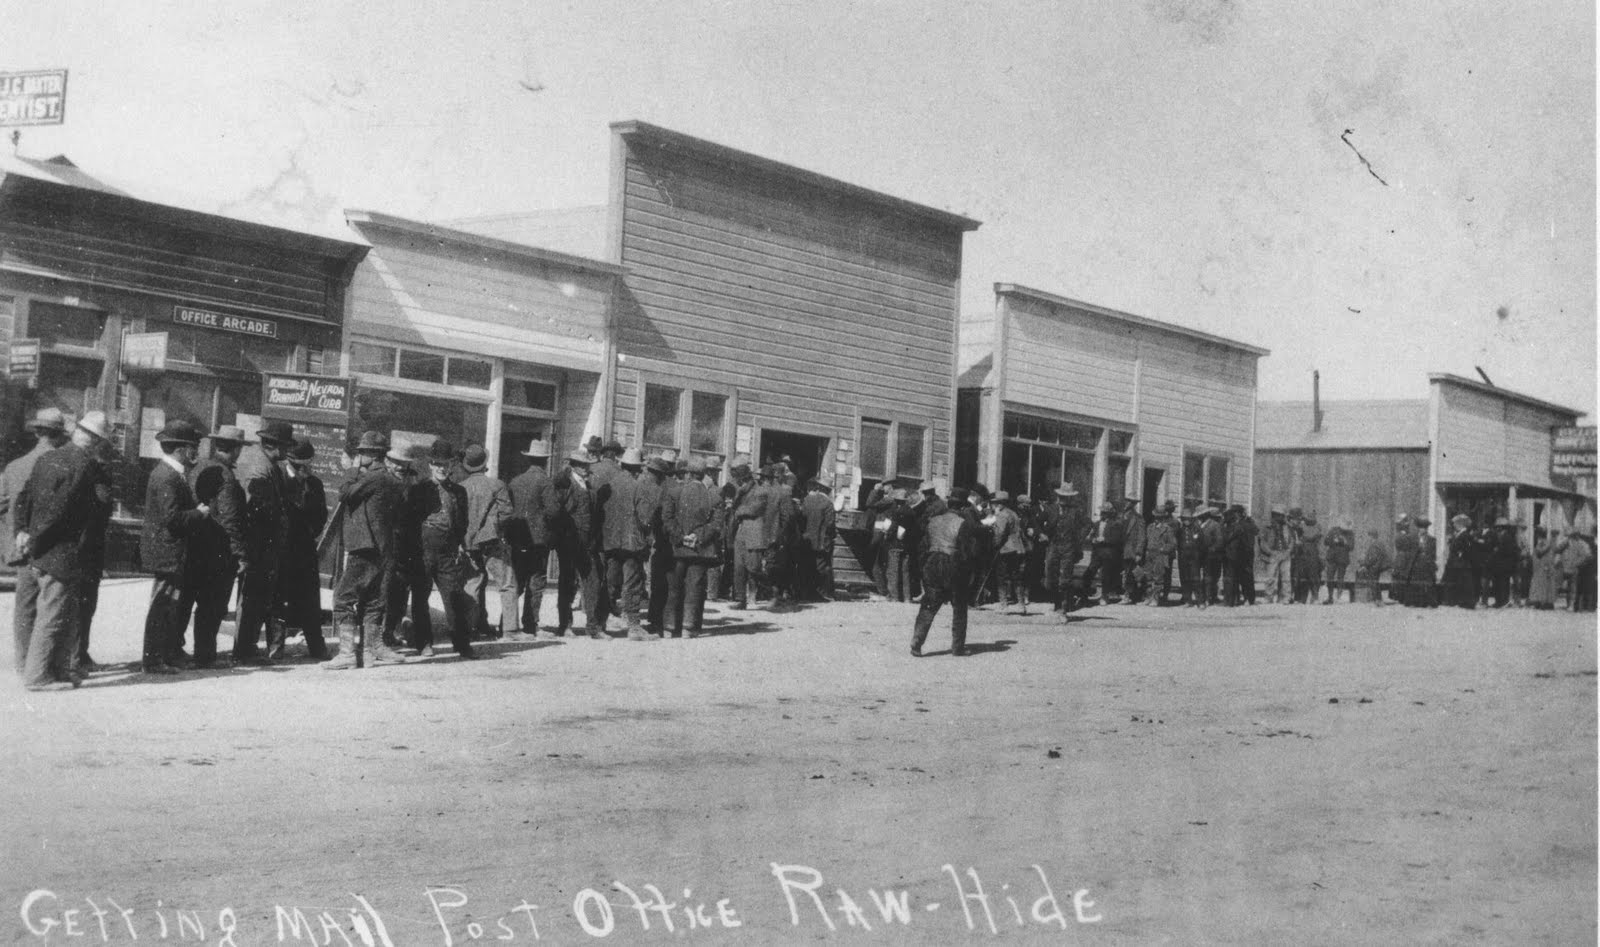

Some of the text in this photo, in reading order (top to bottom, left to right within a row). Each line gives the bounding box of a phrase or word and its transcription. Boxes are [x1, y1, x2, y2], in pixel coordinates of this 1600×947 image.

[181, 310, 273, 334] OFFICE ARCADE.
[305, 380, 345, 406] NEVADA
[318, 394, 342, 410] CURB
